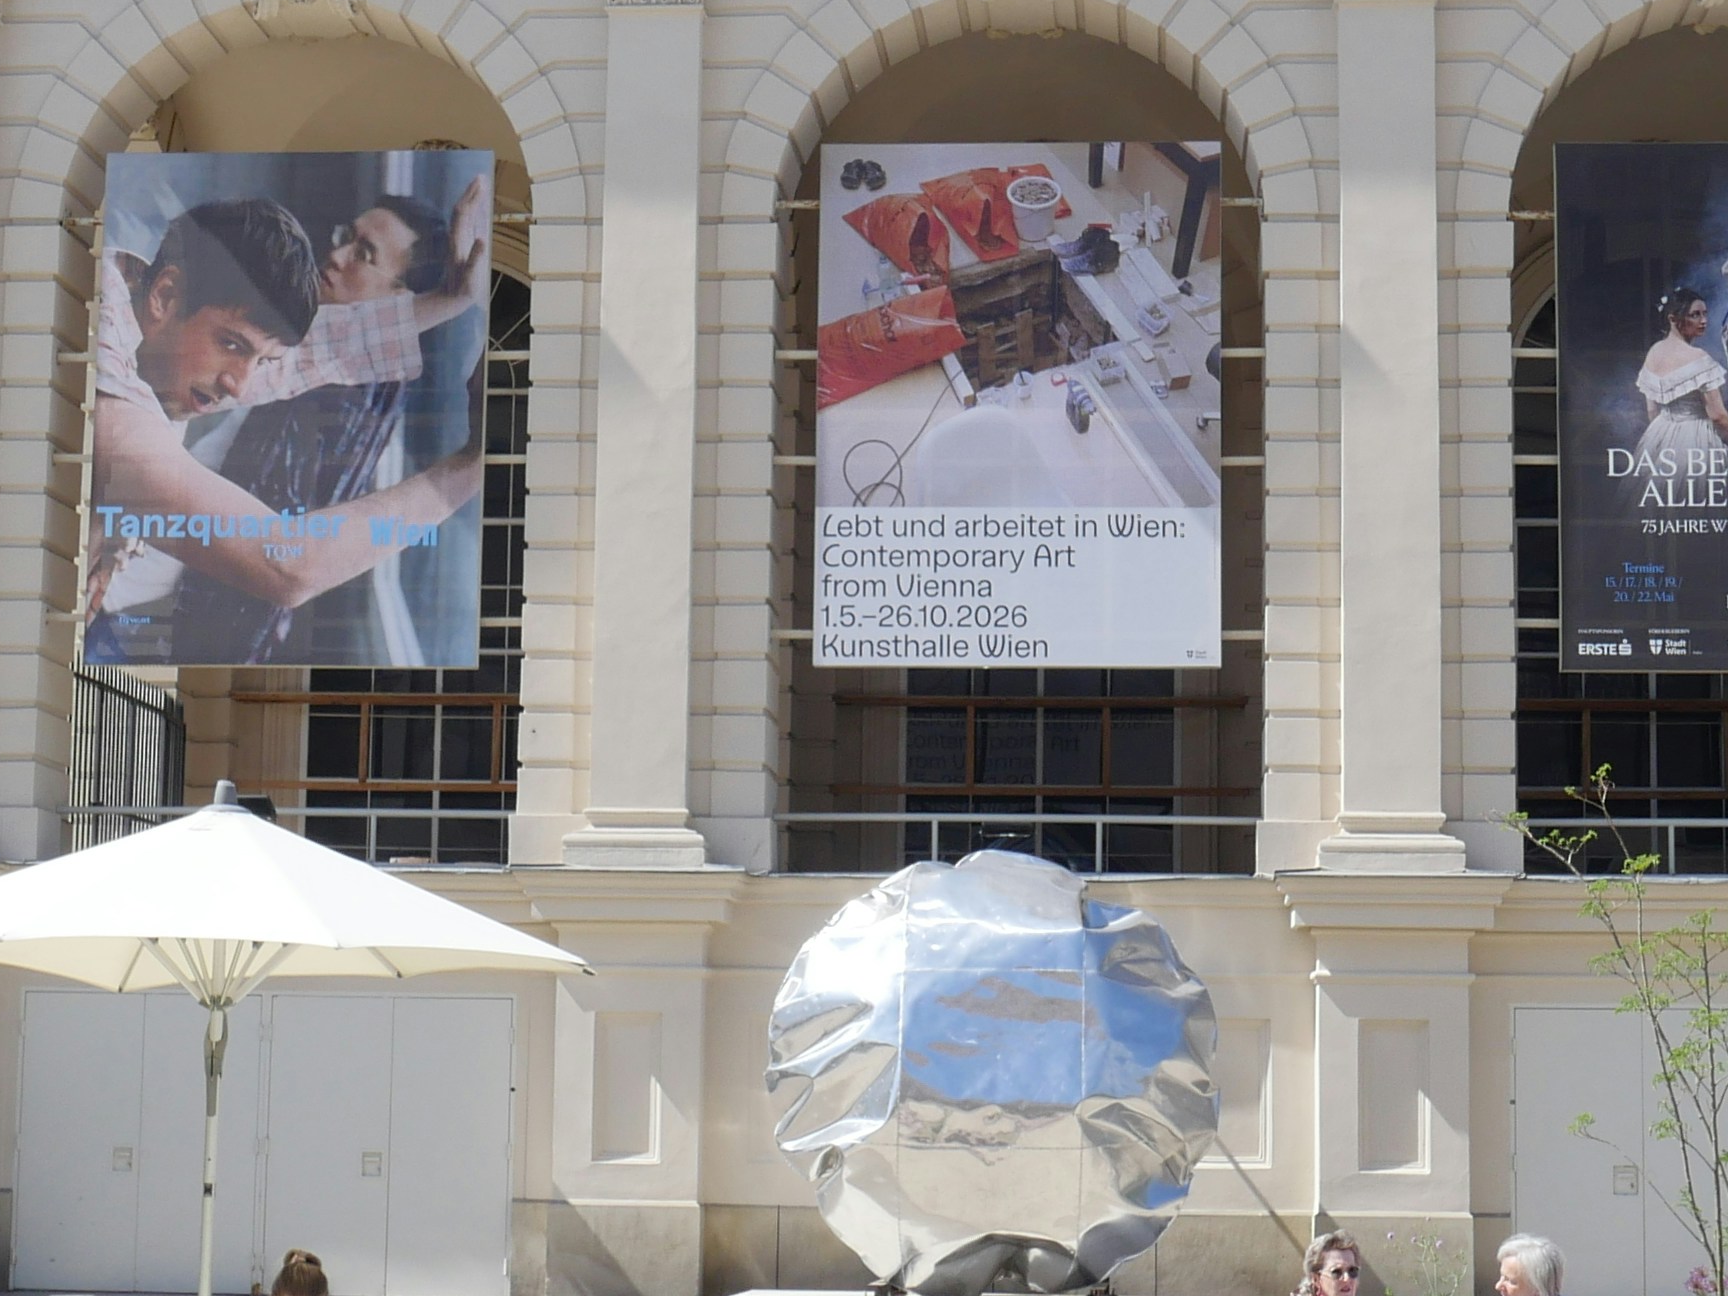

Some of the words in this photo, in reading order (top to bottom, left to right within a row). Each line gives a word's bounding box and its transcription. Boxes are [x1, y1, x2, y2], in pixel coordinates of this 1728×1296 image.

[1607, 448, 1677, 477] DAS
[96, 506, 348, 546] Tanzquartier
[368, 515, 438, 547] Wien
[822, 514, 884, 538] Lebt
[892, 514, 945, 538] und
[954, 514, 1066, 538] arbeitet
[1075, 514, 1098, 538] in
[1107, 514, 1185, 538] Wien:
[1641, 519, 1657, 534] 75
[1658, 519, 1709, 536] JAHRE
[822, 543, 1025, 573] Contemporary
[1034, 543, 1076, 567] Art
[1622, 562, 1665, 574] Termine
[821, 574, 887, 598] from
[896, 574, 993, 598] Vienna
[1654, 591, 1674, 602] Mai
[822, 634, 969, 658] Kunsthalle
[978, 634, 1048, 658] Wien
[1578, 643, 1617, 655] ERSTE
[1665, 639, 1686, 648] Stadt
[1665, 647, 1686, 655] Wien
